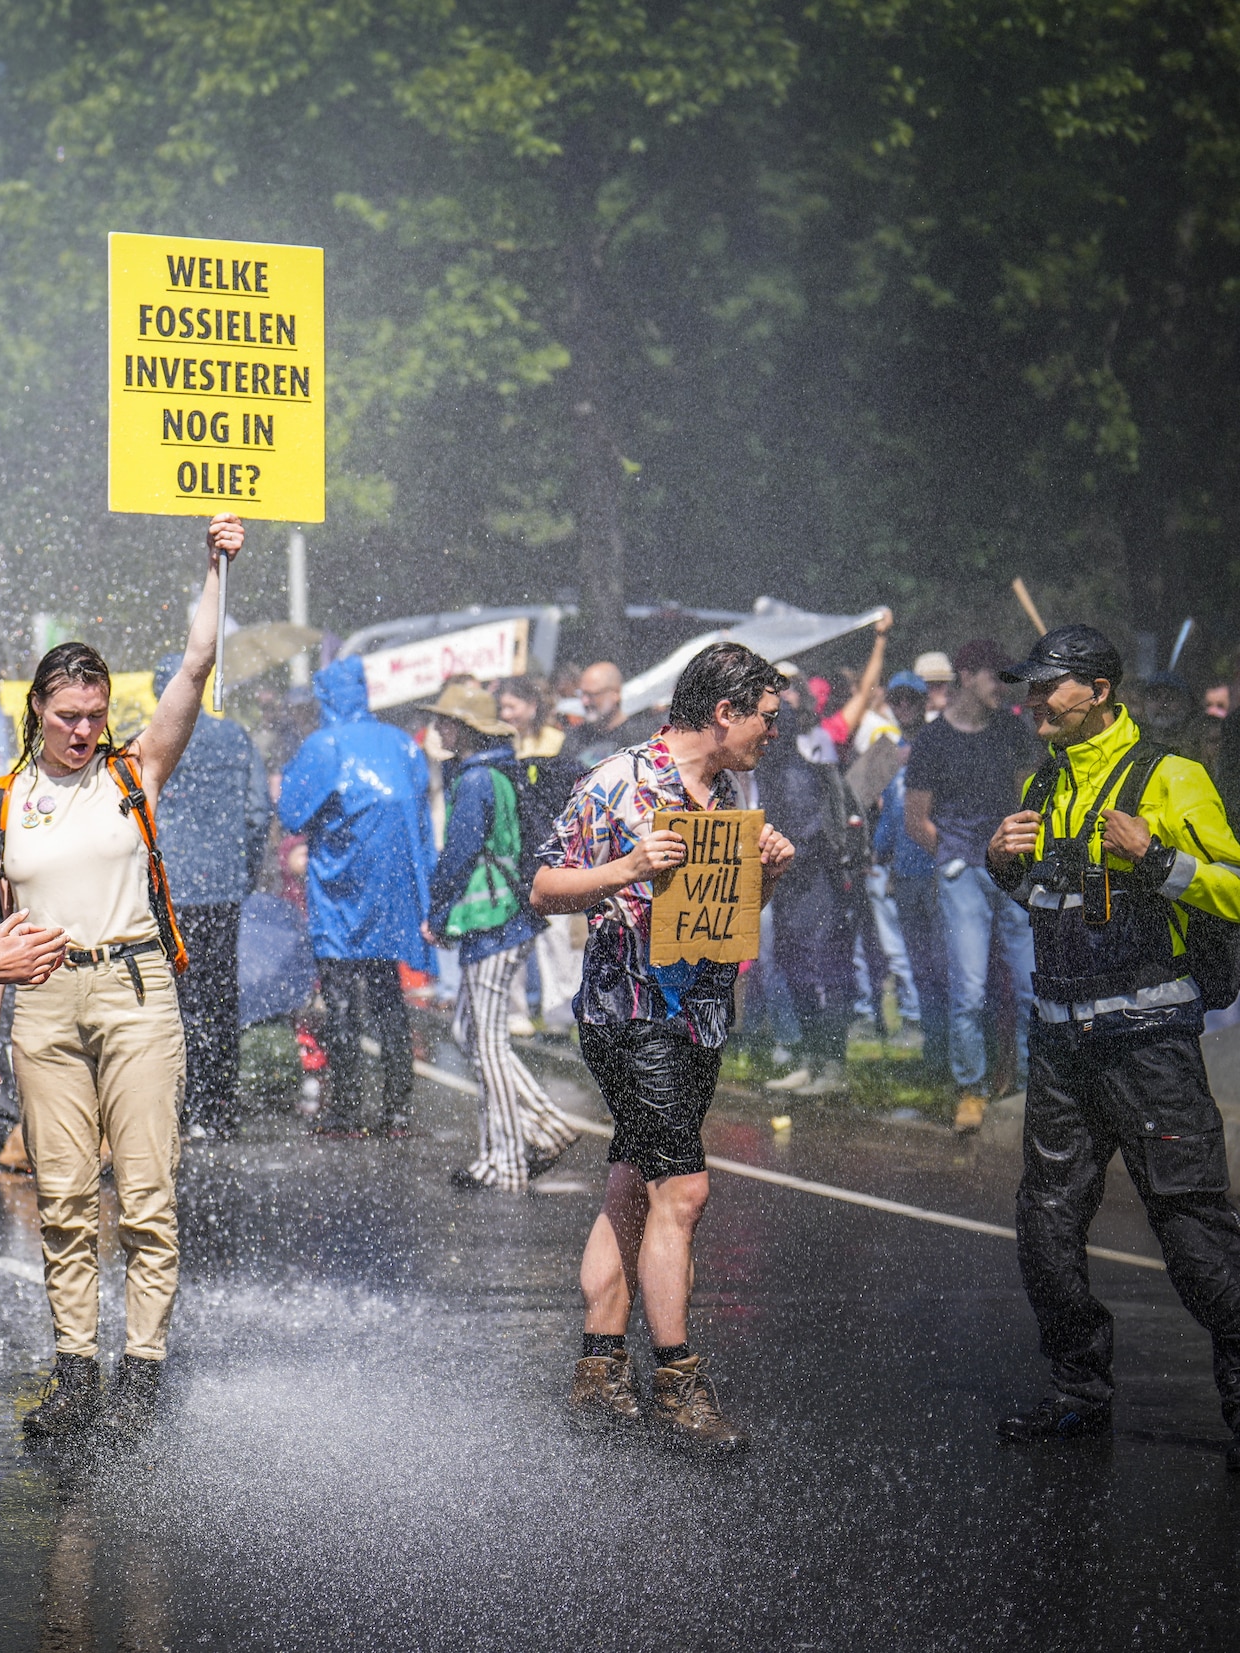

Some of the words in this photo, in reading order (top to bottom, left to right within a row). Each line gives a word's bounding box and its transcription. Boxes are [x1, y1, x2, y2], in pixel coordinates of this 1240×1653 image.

[166, 255, 269, 292] WELKE
[139, 304, 296, 345] FOSSIELEN
[125, 354, 310, 397] INVESTEREN
[162, 408, 230, 443] NOG
[242, 413, 274, 446] IN
[177, 461, 261, 496] OLIE?
[668, 817, 742, 868] SHELL
[676, 906, 734, 941] FALL
